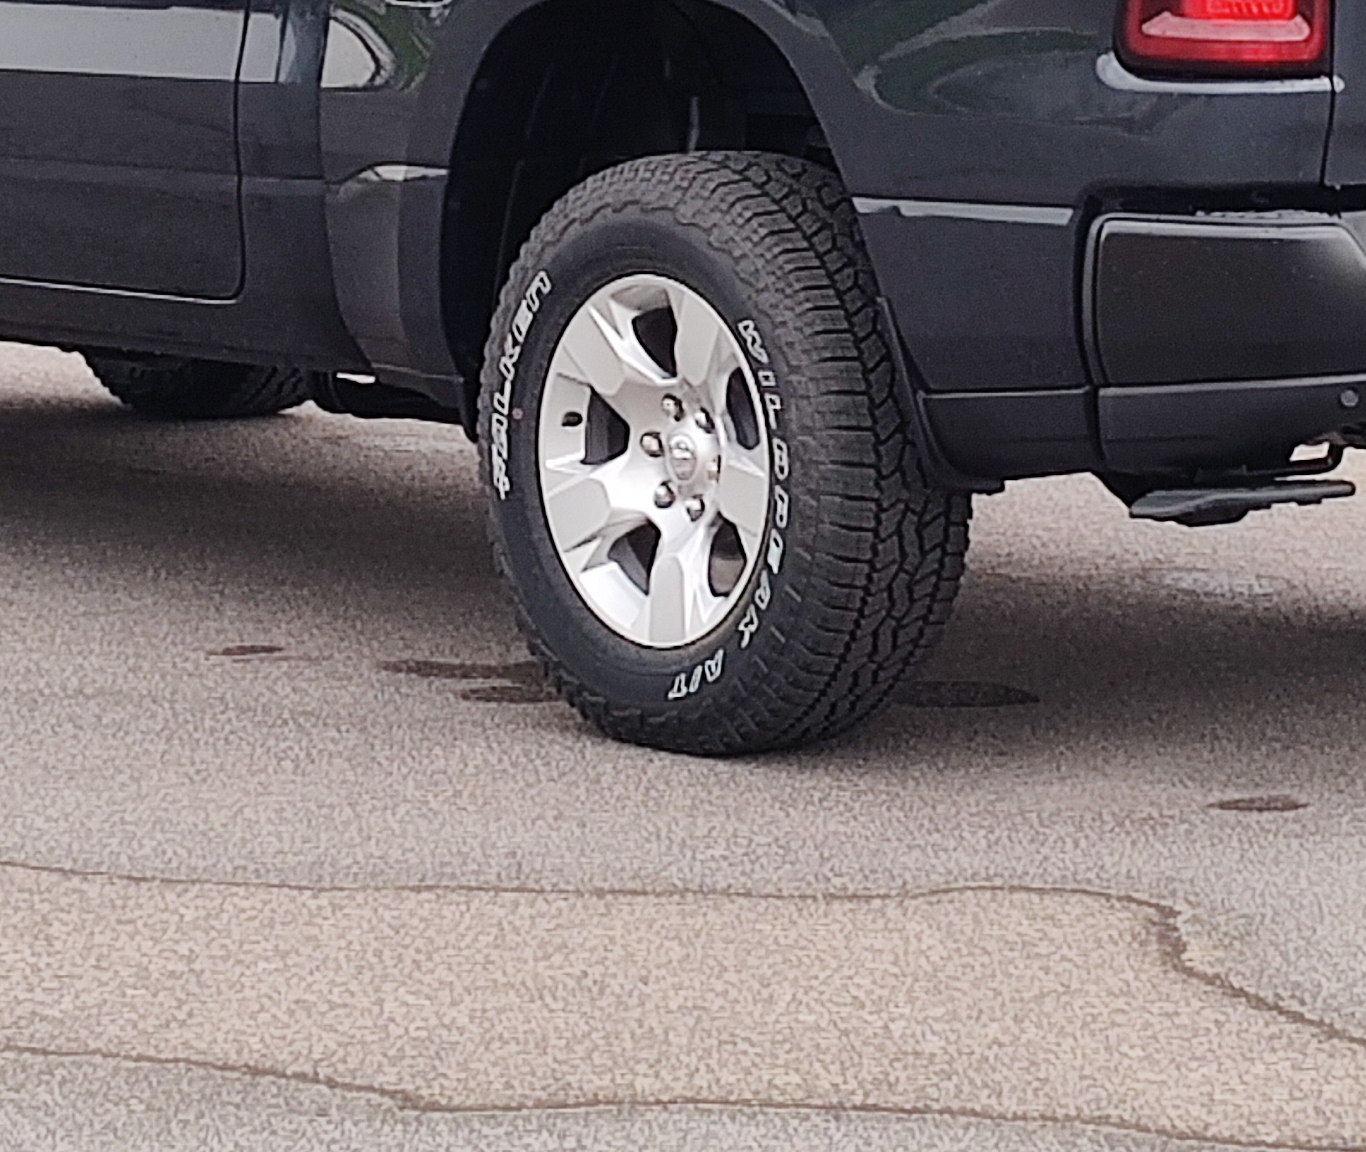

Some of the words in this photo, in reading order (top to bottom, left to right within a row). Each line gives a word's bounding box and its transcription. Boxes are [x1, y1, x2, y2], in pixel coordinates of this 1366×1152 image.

[491, 270, 553, 500] FALKEN
[738, 318, 791, 648] WILDPEAK
[666, 647, 728, 701] A/T
